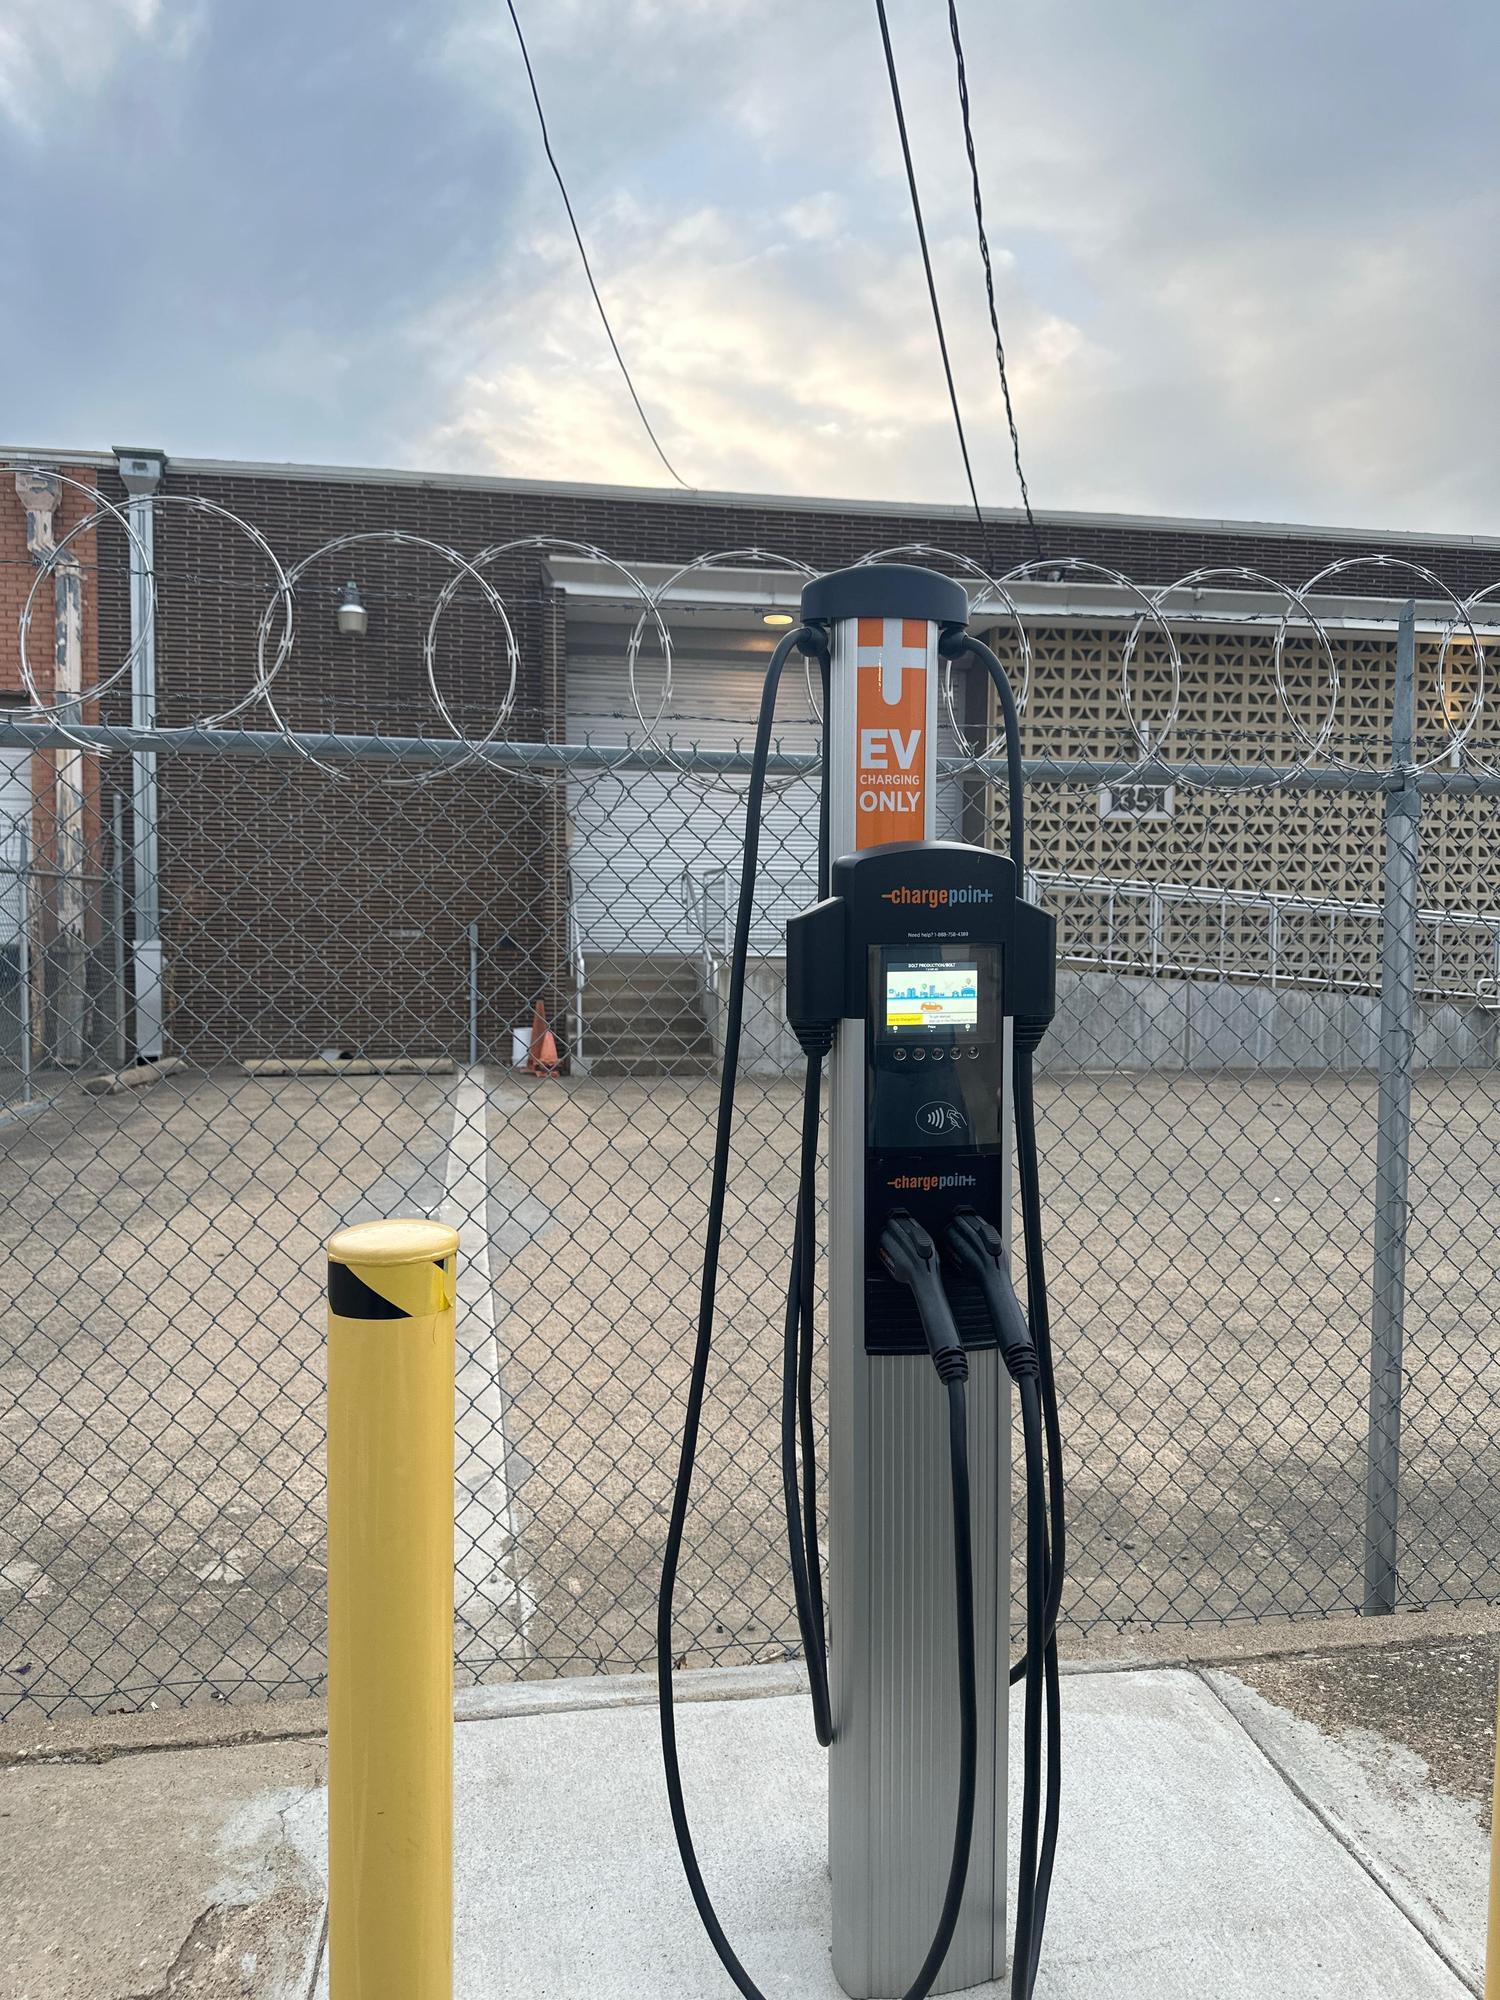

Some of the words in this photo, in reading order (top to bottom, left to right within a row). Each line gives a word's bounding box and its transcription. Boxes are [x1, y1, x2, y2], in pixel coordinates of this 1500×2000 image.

[860, 728, 921, 769] EV
[860, 774, 920, 786] CHARGING
[859, 790, 921, 813] ONLY
